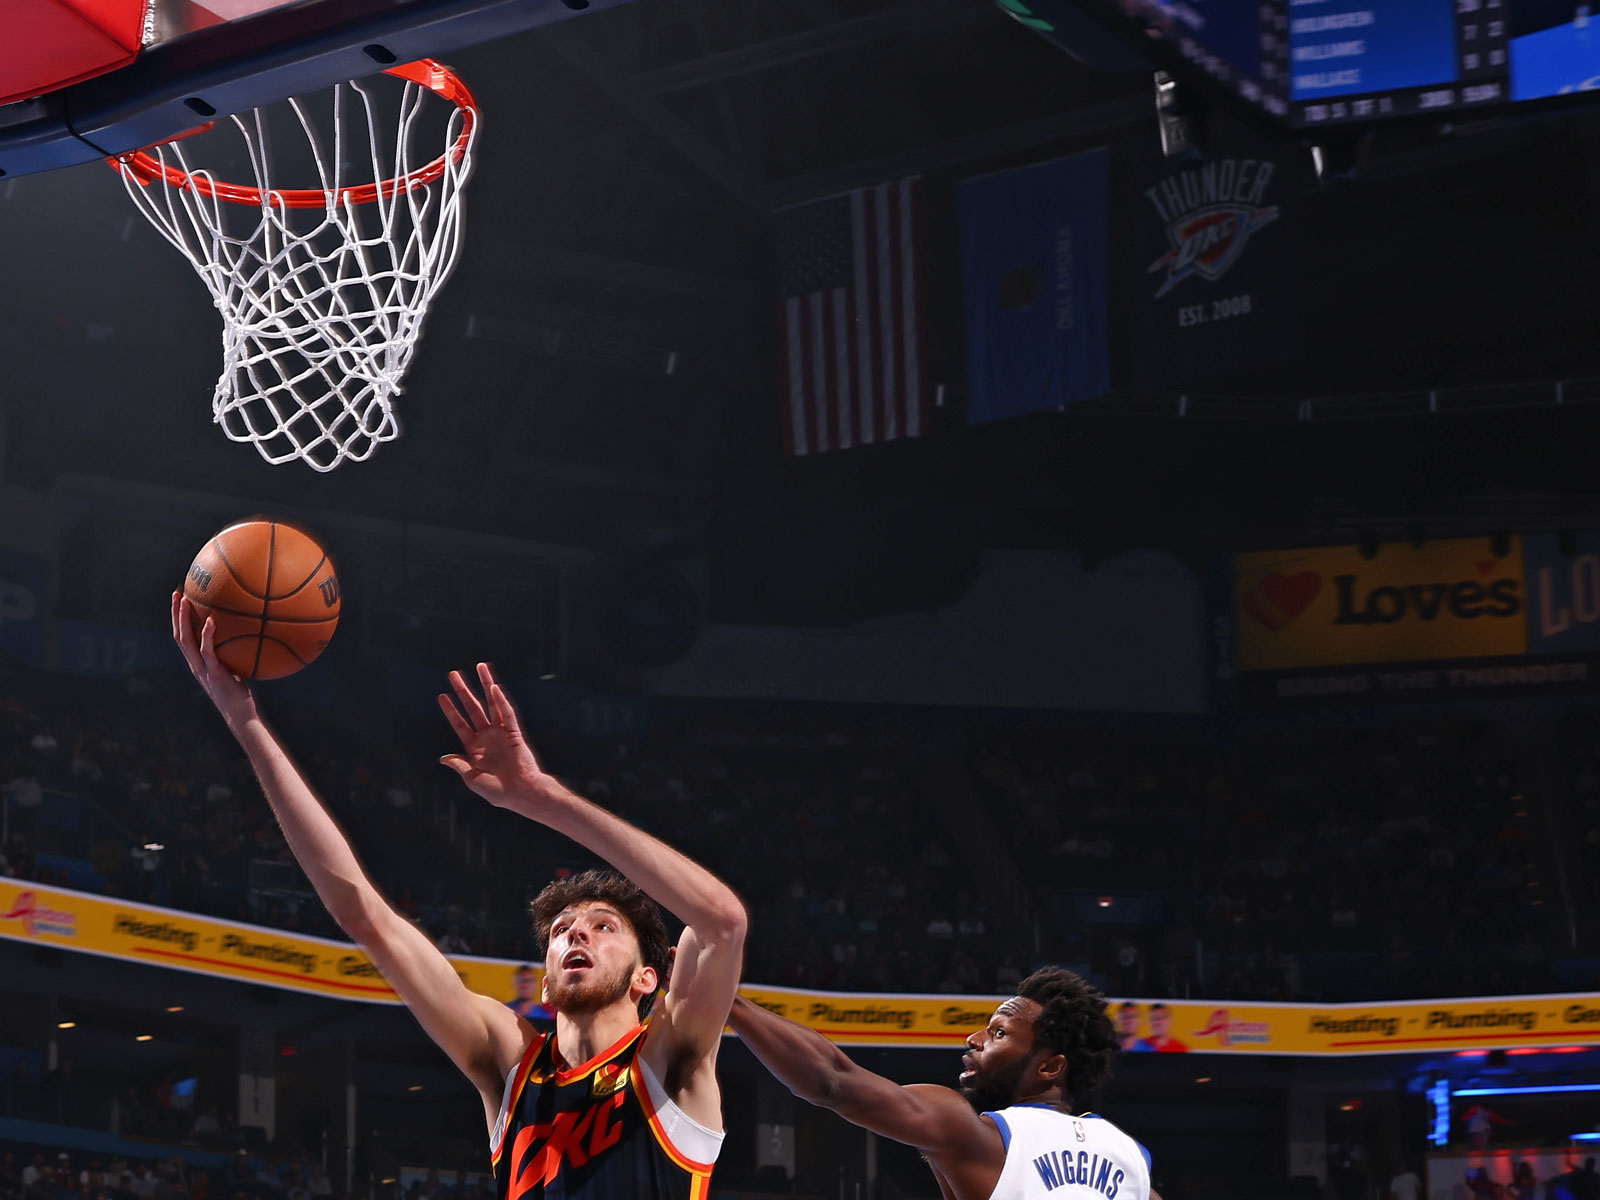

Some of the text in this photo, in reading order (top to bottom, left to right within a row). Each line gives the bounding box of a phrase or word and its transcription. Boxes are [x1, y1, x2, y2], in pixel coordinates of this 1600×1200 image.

[1145, 158, 1275, 224] THUNDER
[1178, 293, 1252, 328] EST. 2008
[1446, 660, 1588, 688] THUNDER
[112, 913, 200, 951] Heating
[221, 932, 316, 974] Plumbing
[807, 1002, 915, 1029] Plumbing
[1308, 1014, 1399, 1037] Heating
[1425, 1008, 1538, 1031] Plumbing
[1032, 1149, 1125, 1200] WIGGINS
